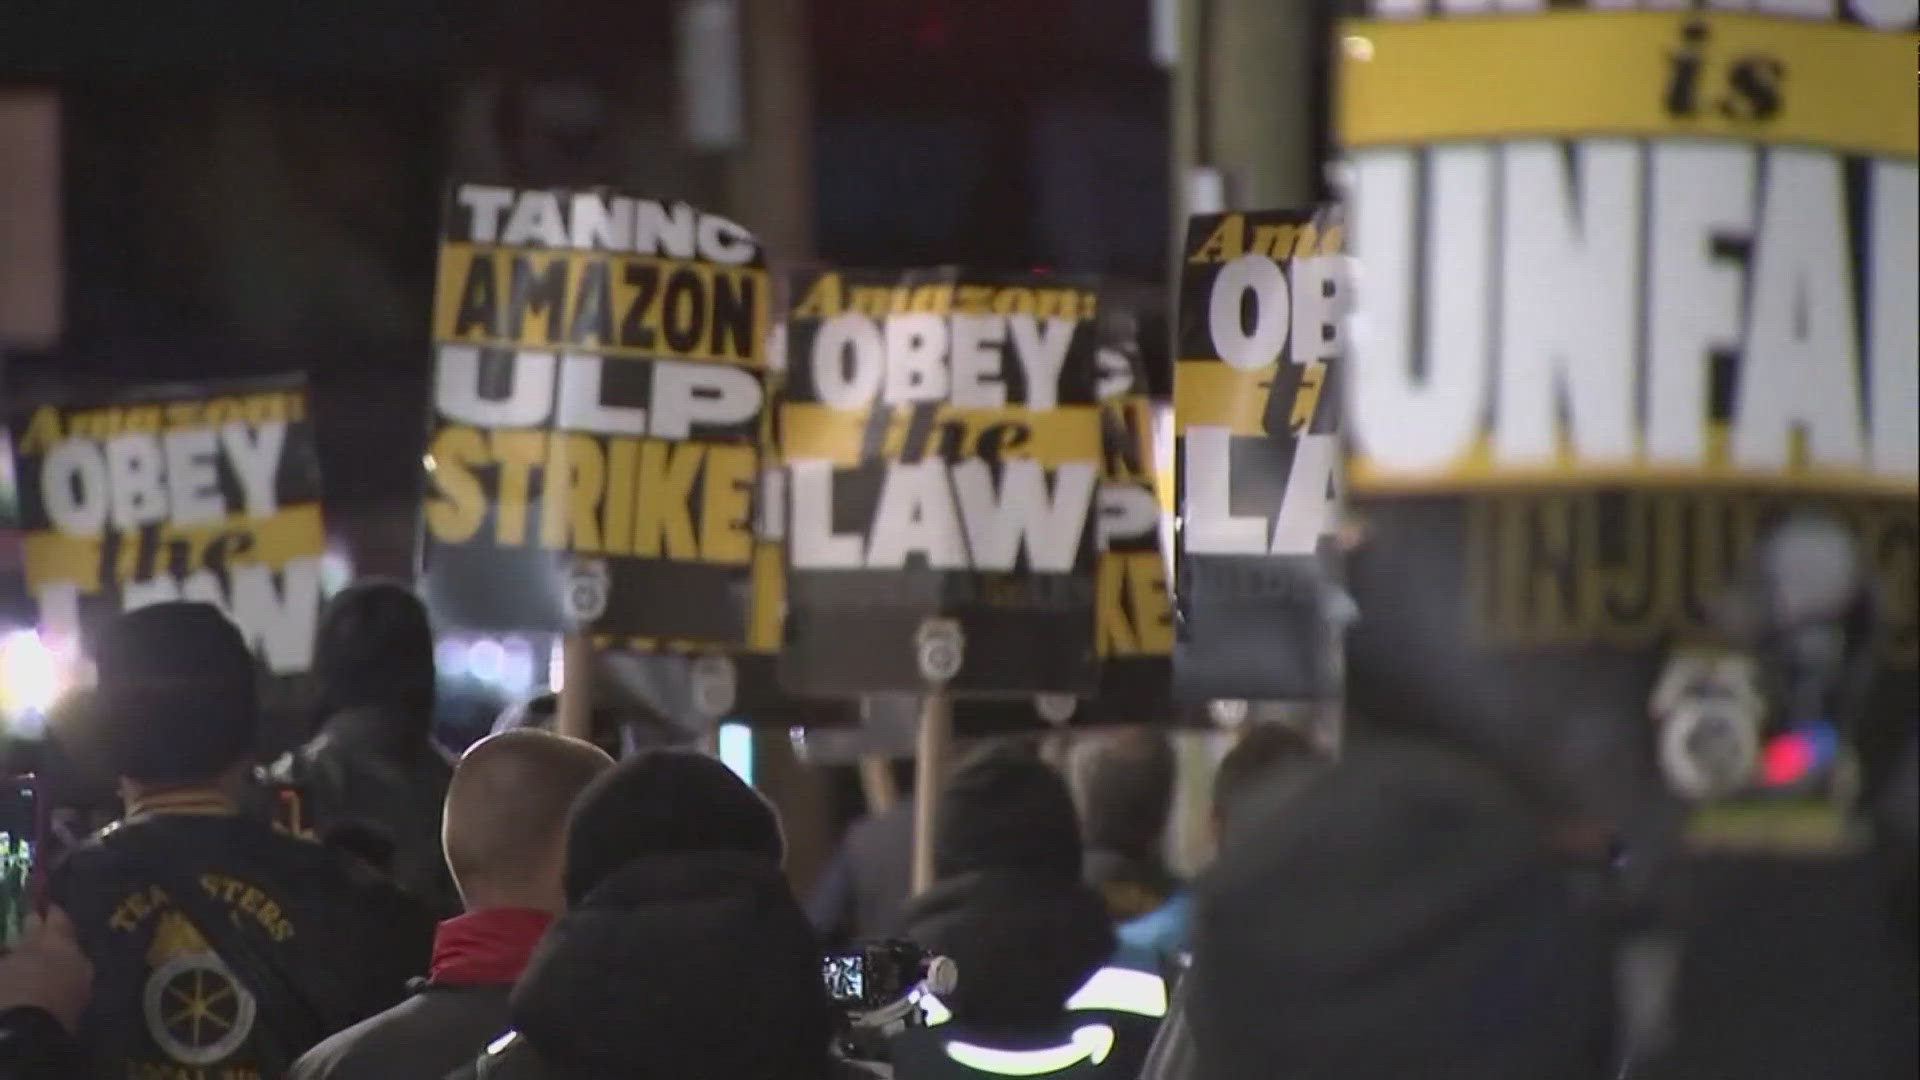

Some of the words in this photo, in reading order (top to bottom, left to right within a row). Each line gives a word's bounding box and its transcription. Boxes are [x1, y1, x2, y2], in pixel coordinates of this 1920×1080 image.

[1664, 20, 1787, 120] is
[454, 252, 755, 358] AMAZON
[1208, 253, 1344, 369] OB
[434, 343, 764, 441] ULP
[811, 312, 1076, 412] OBEY
[41, 420, 286, 541] OBEY
[858, 398, 1032, 471] the
[424, 423, 757, 565] STRIKE
[790, 456, 1098, 573] LAW
[1186, 427, 1340, 554] LA
[110, 873, 295, 942] TEASTERS
